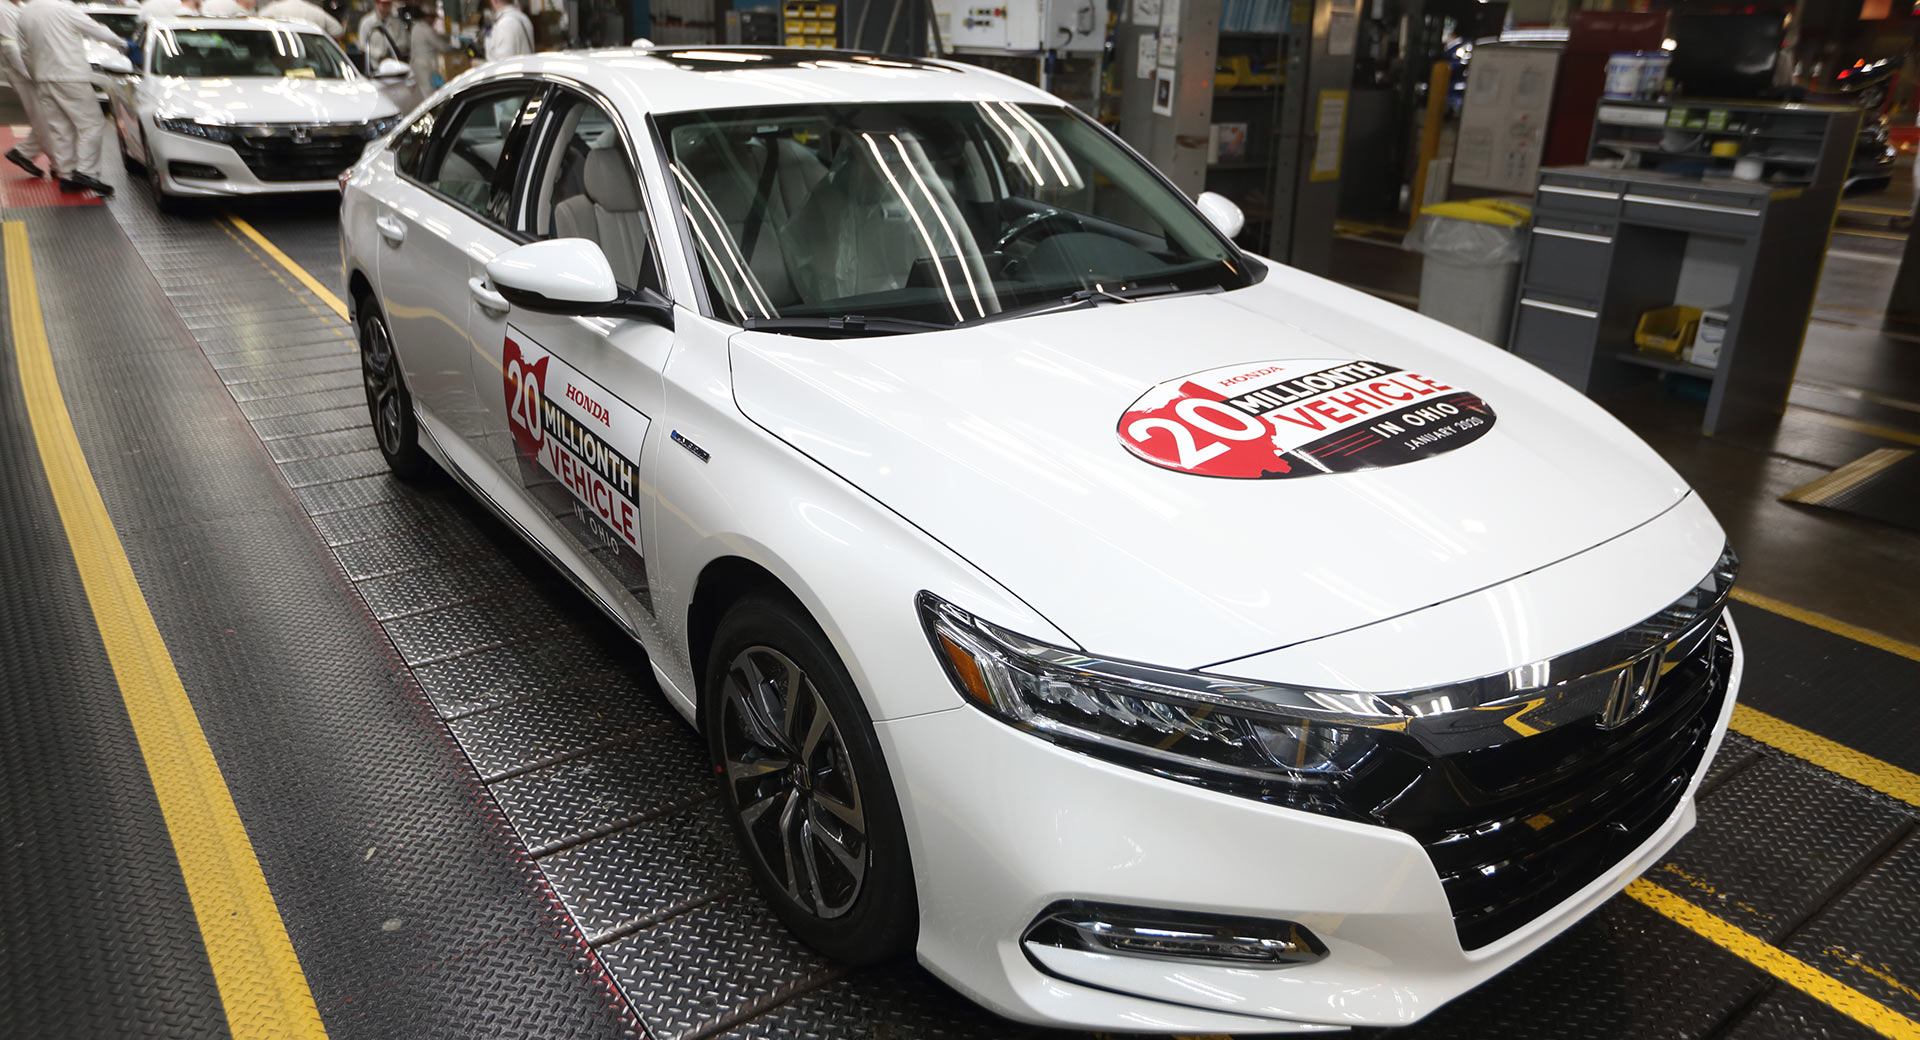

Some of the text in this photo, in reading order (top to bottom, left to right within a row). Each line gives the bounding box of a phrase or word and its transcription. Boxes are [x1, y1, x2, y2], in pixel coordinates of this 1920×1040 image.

[507, 359, 544, 441] 20
[1219, 366, 1285, 387] HONDA
[1229, 361, 1386, 415] MILLIONTH
[1273, 373, 1454, 431] VEHICLE
[566, 383, 610, 427] HONDA
[1370, 402, 1460, 438] IN OHIO
[544, 401, 633, 497] MILLIONTH
[1128, 398, 1266, 469] 20
[1404, 416, 1485, 451] JANUARY 2020
[547, 437, 636, 545] VEHICLE
[573, 501, 619, 555] IN OHIO
